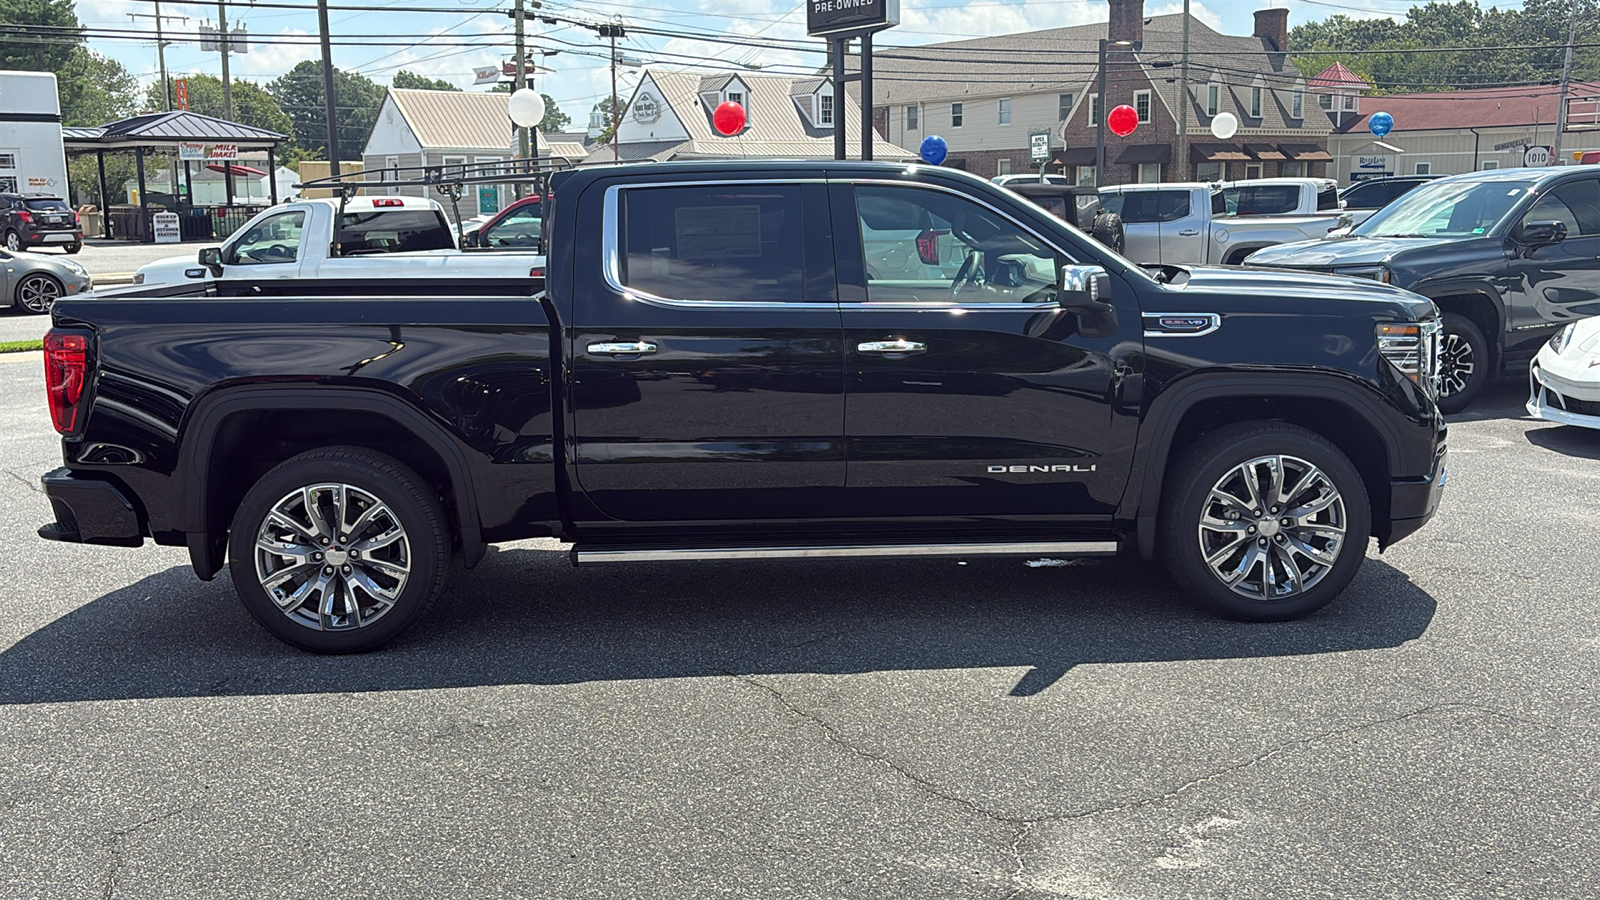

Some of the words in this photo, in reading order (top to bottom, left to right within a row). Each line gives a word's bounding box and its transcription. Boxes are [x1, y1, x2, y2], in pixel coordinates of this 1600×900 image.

[815, 0, 873, 13] PRE-OWNED
[1527, 152, 1547, 163] 1010
[987, 464, 1096, 473] DENALI
